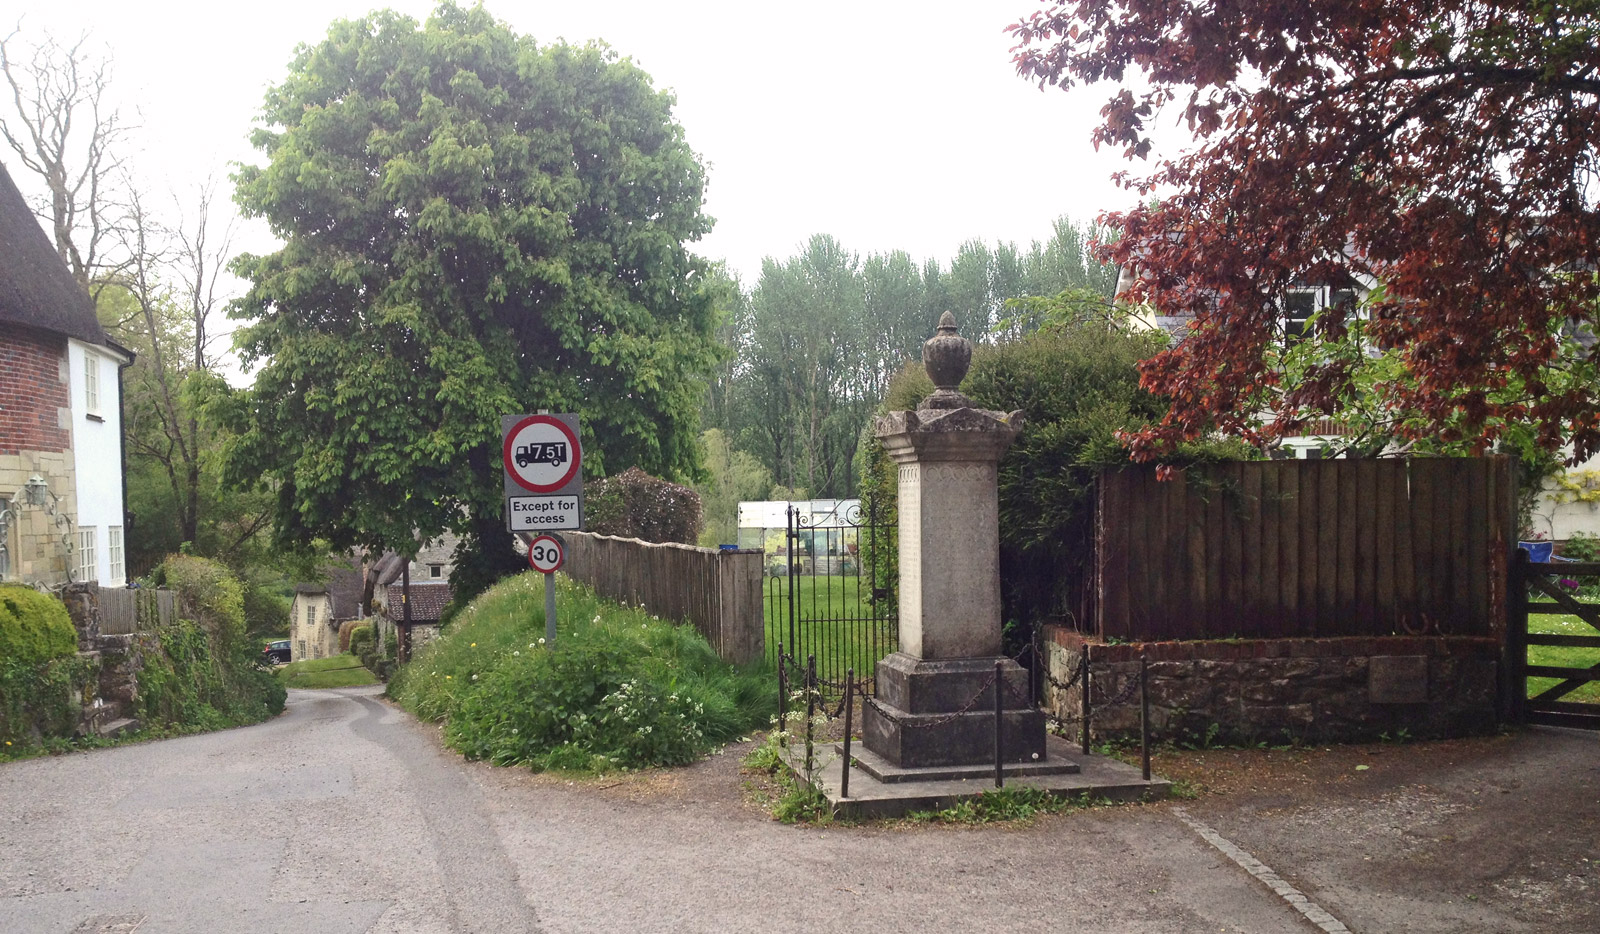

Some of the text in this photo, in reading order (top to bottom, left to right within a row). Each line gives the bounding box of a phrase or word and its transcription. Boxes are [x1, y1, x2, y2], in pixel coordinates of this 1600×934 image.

[532, 444, 564, 459] 7.5T
[513, 500, 575, 513] Except for
[525, 514, 565, 524] access
[533, 545, 558, 564] 30
